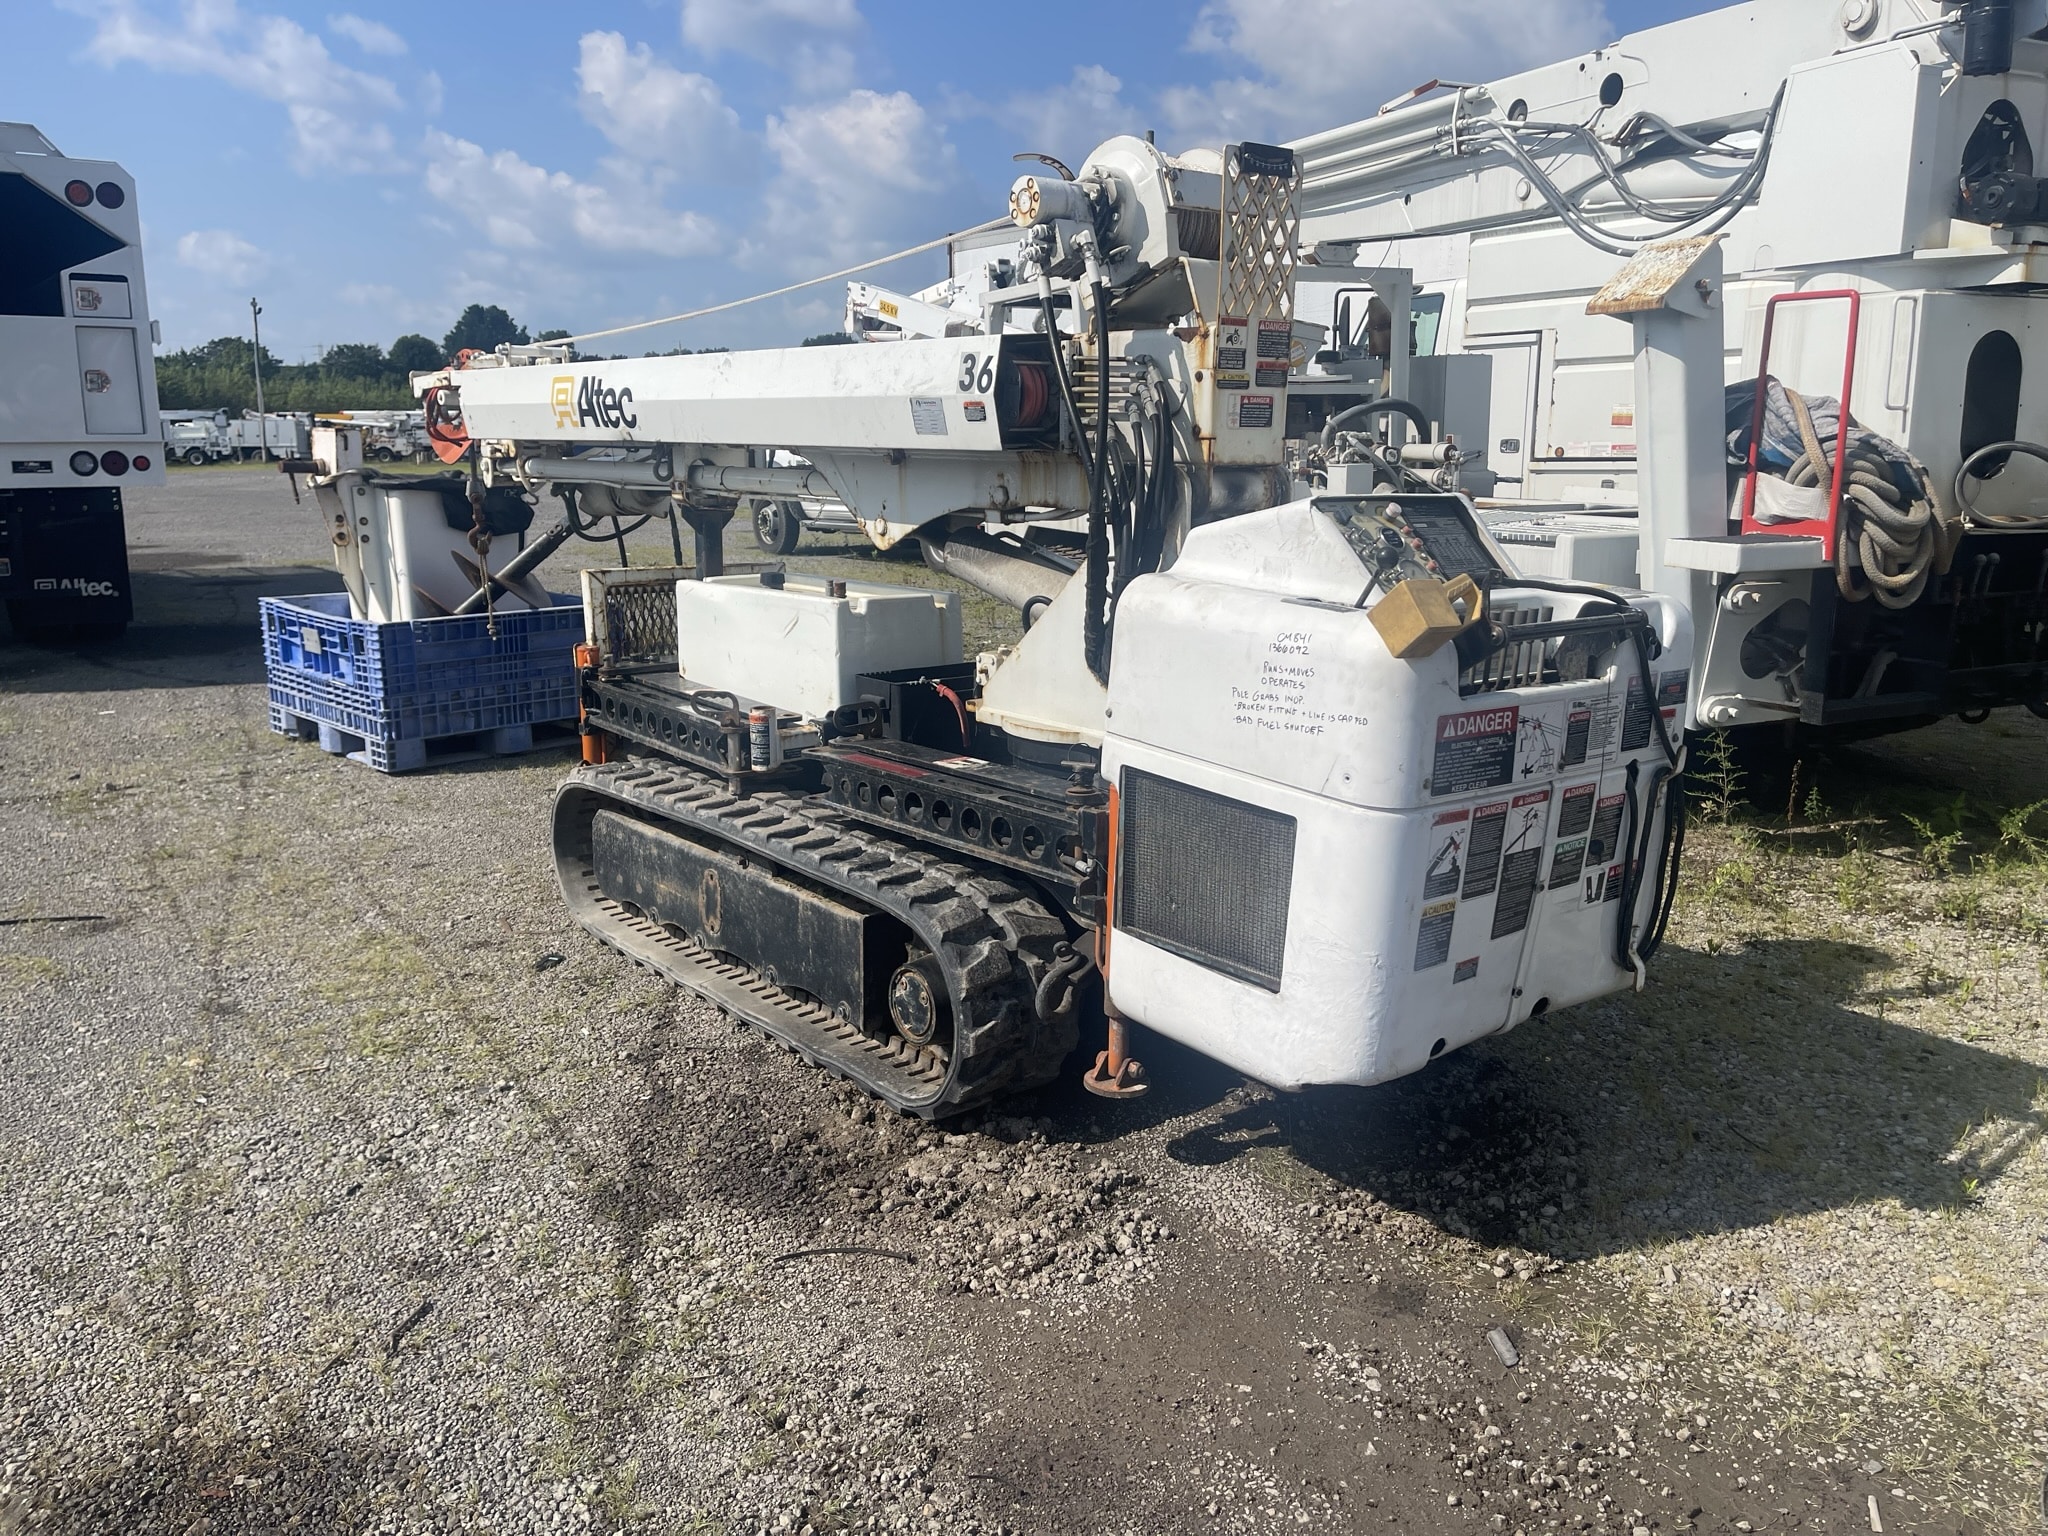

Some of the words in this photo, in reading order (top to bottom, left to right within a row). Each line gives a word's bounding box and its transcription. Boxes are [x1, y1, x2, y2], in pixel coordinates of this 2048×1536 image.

[1265, 321, 1290, 331] DANGER
[959, 353, 994, 394] 36
[577, 376, 638, 429] Altec
[1261, 677, 1306, 689] OPERATES
[1232, 686, 1249, 699] POLE
[1252, 690, 1279, 701] GRABS
[1308, 710, 1326, 720] LINE
[1257, 717, 1281, 730] FUEL
[1457, 711, 1513, 736] DANGER
[1451, 784, 1467, 793] KEEP
[1468, 781, 1488, 789] CLEAR
[1570, 784, 1595, 796] DANGER
[1524, 794, 1544, 803] DANGER
[1602, 794, 1625, 807] DANGER
[1481, 803, 1507, 816] DANGER
[1562, 838, 1585, 851] NOTICE
[1428, 901, 1456, 915] CAUTION
